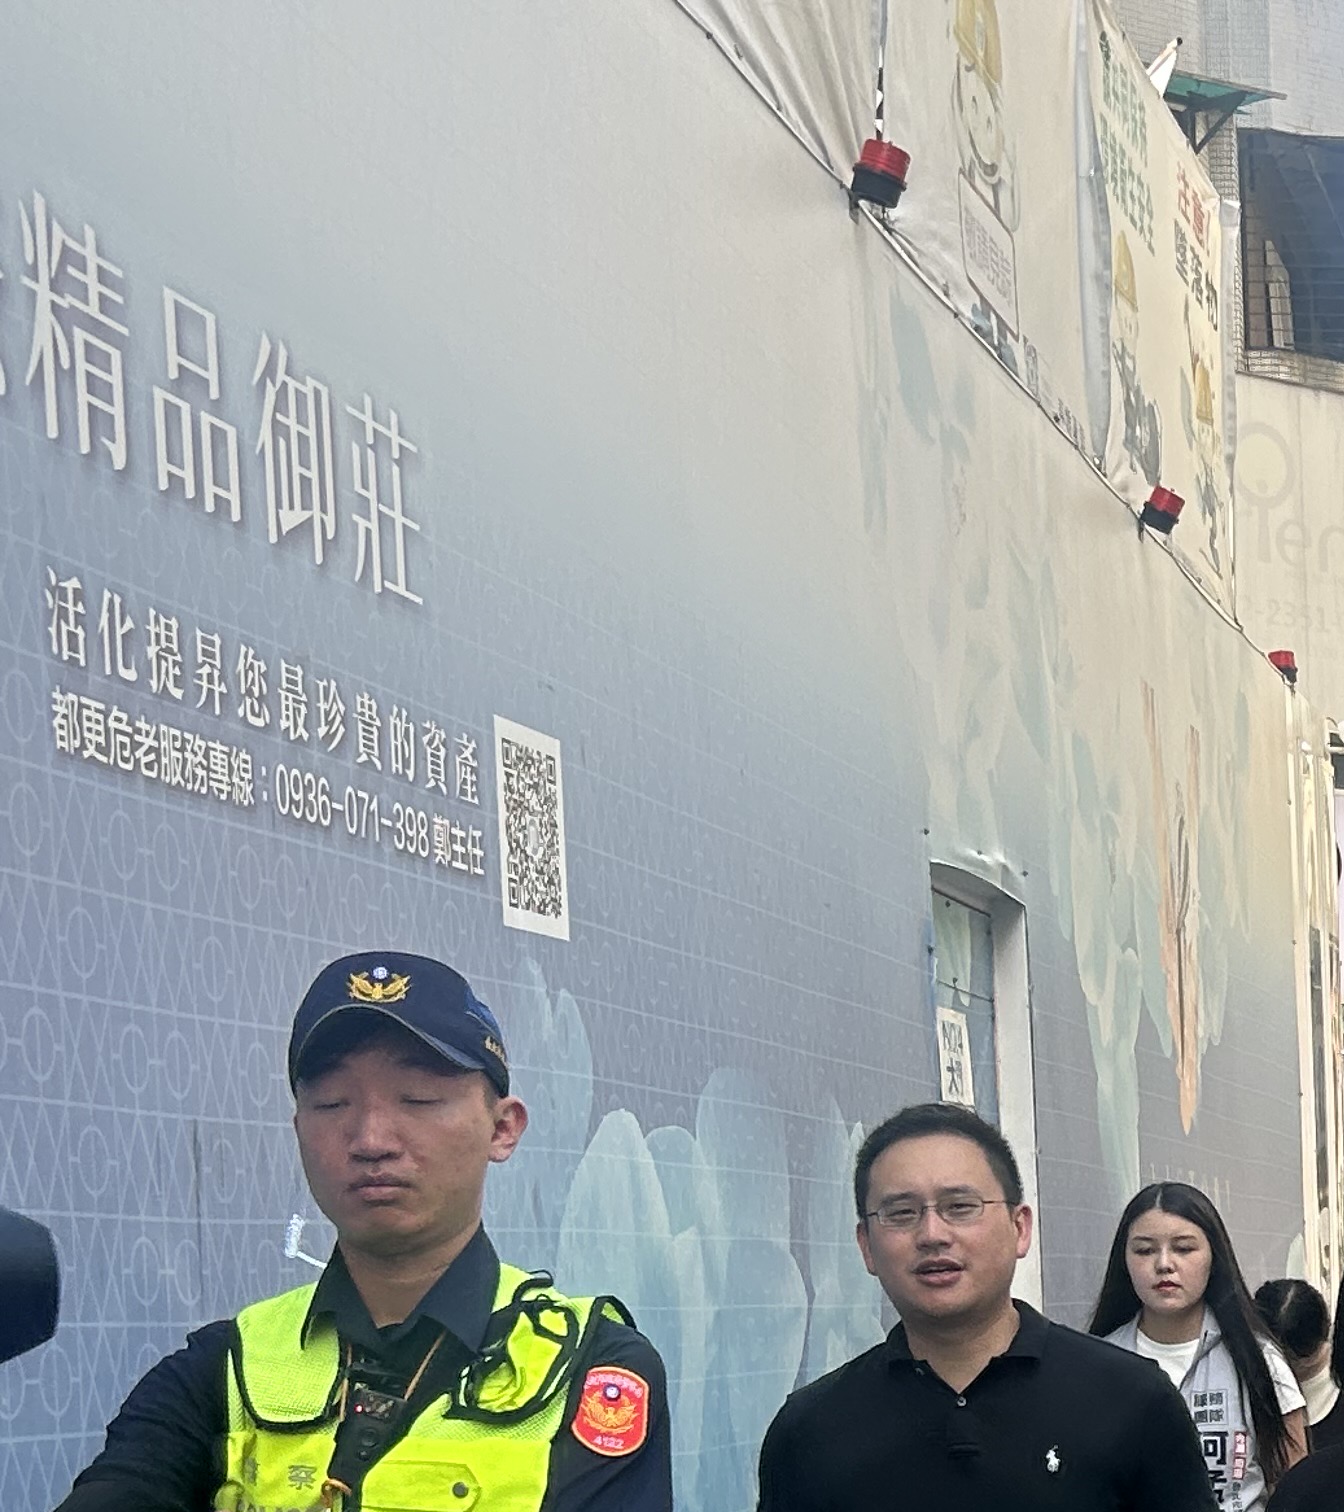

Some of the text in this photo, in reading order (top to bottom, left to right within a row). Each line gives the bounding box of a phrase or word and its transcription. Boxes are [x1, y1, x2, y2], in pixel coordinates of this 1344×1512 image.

[0, 190, 424, 604] 精品御莊
[44, 565, 481, 807] 活化提昇您最珍貴的資產
